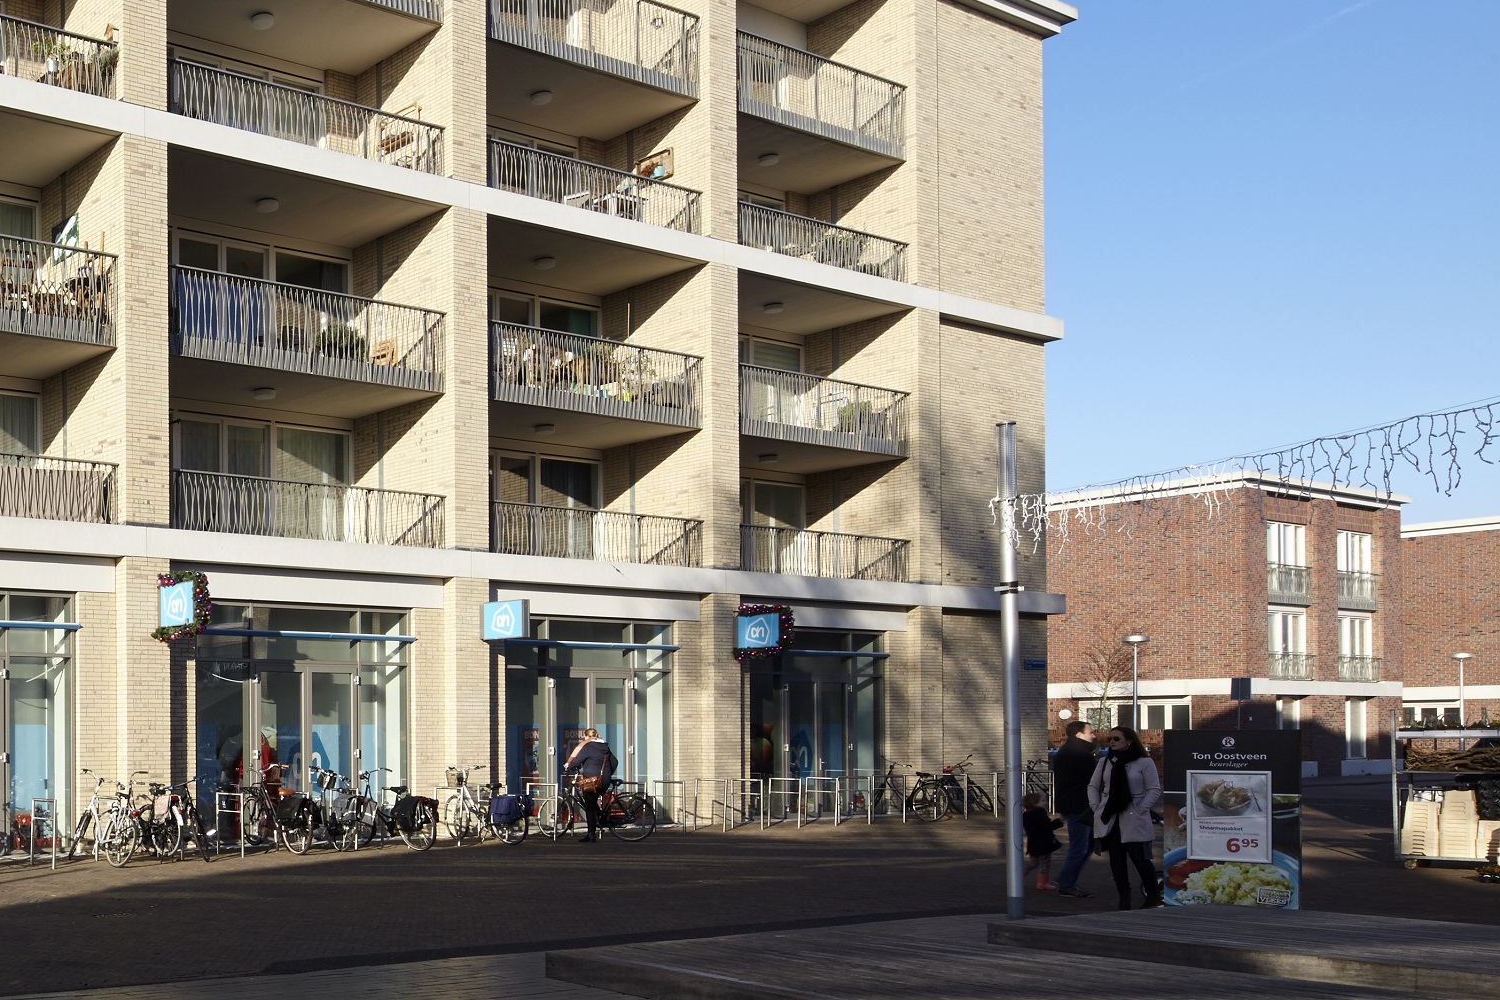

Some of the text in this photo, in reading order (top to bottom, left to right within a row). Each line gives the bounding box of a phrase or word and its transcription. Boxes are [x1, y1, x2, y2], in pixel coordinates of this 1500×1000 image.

[524, 730, 539, 739] BON
[565, 730, 585, 739] BONU
[1192, 752, 1267, 760] Ton Oostveen
